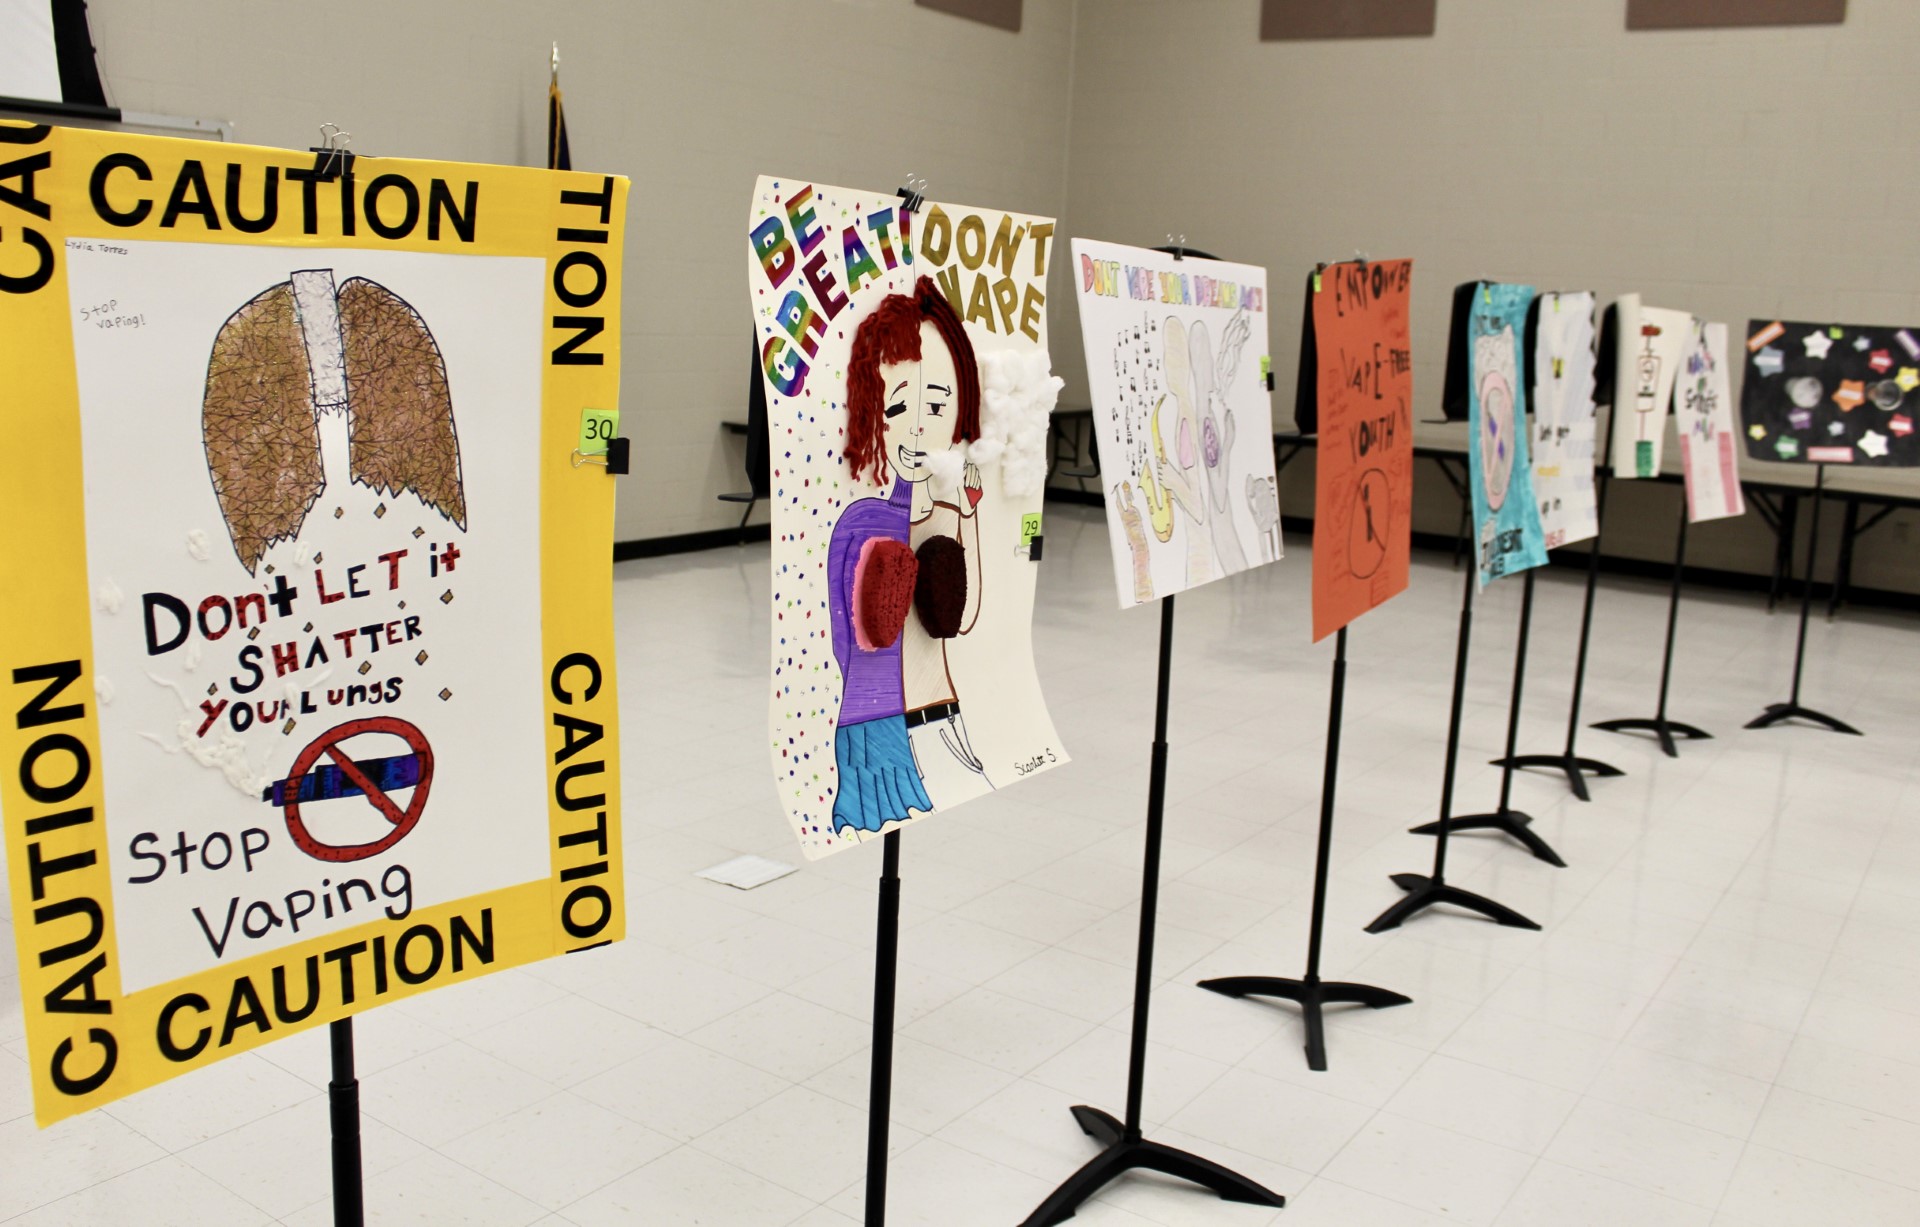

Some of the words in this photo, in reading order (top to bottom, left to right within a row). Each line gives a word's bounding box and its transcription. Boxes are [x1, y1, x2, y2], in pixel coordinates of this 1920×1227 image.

[88, 152, 479, 243] CAUTION
[749, 184, 827, 290] BE
[64, 240, 94, 251] Lydia
[98, 244, 128, 256] Torres
[551, 177, 614, 366] TION
[920, 203, 1055, 278] DON'T
[762, 206, 914, 398] GREAT!
[935, 263, 1046, 344] VAPE
[1124, 265, 1156, 302] VAPE
[585, 418, 613, 440] 30
[1348, 410, 1396, 465] YOUTH
[1024, 520, 1038, 536] 29
[314, 549, 408, 605] LET
[430, 542, 461, 578] it
[230, 615, 423, 695] SHATTER
[551, 652, 614, 955] CAUTIO
[12, 659, 119, 1097] CAUTION
[192, 864, 413, 959] Vaping
[156, 908, 495, 1063] CAUTION
